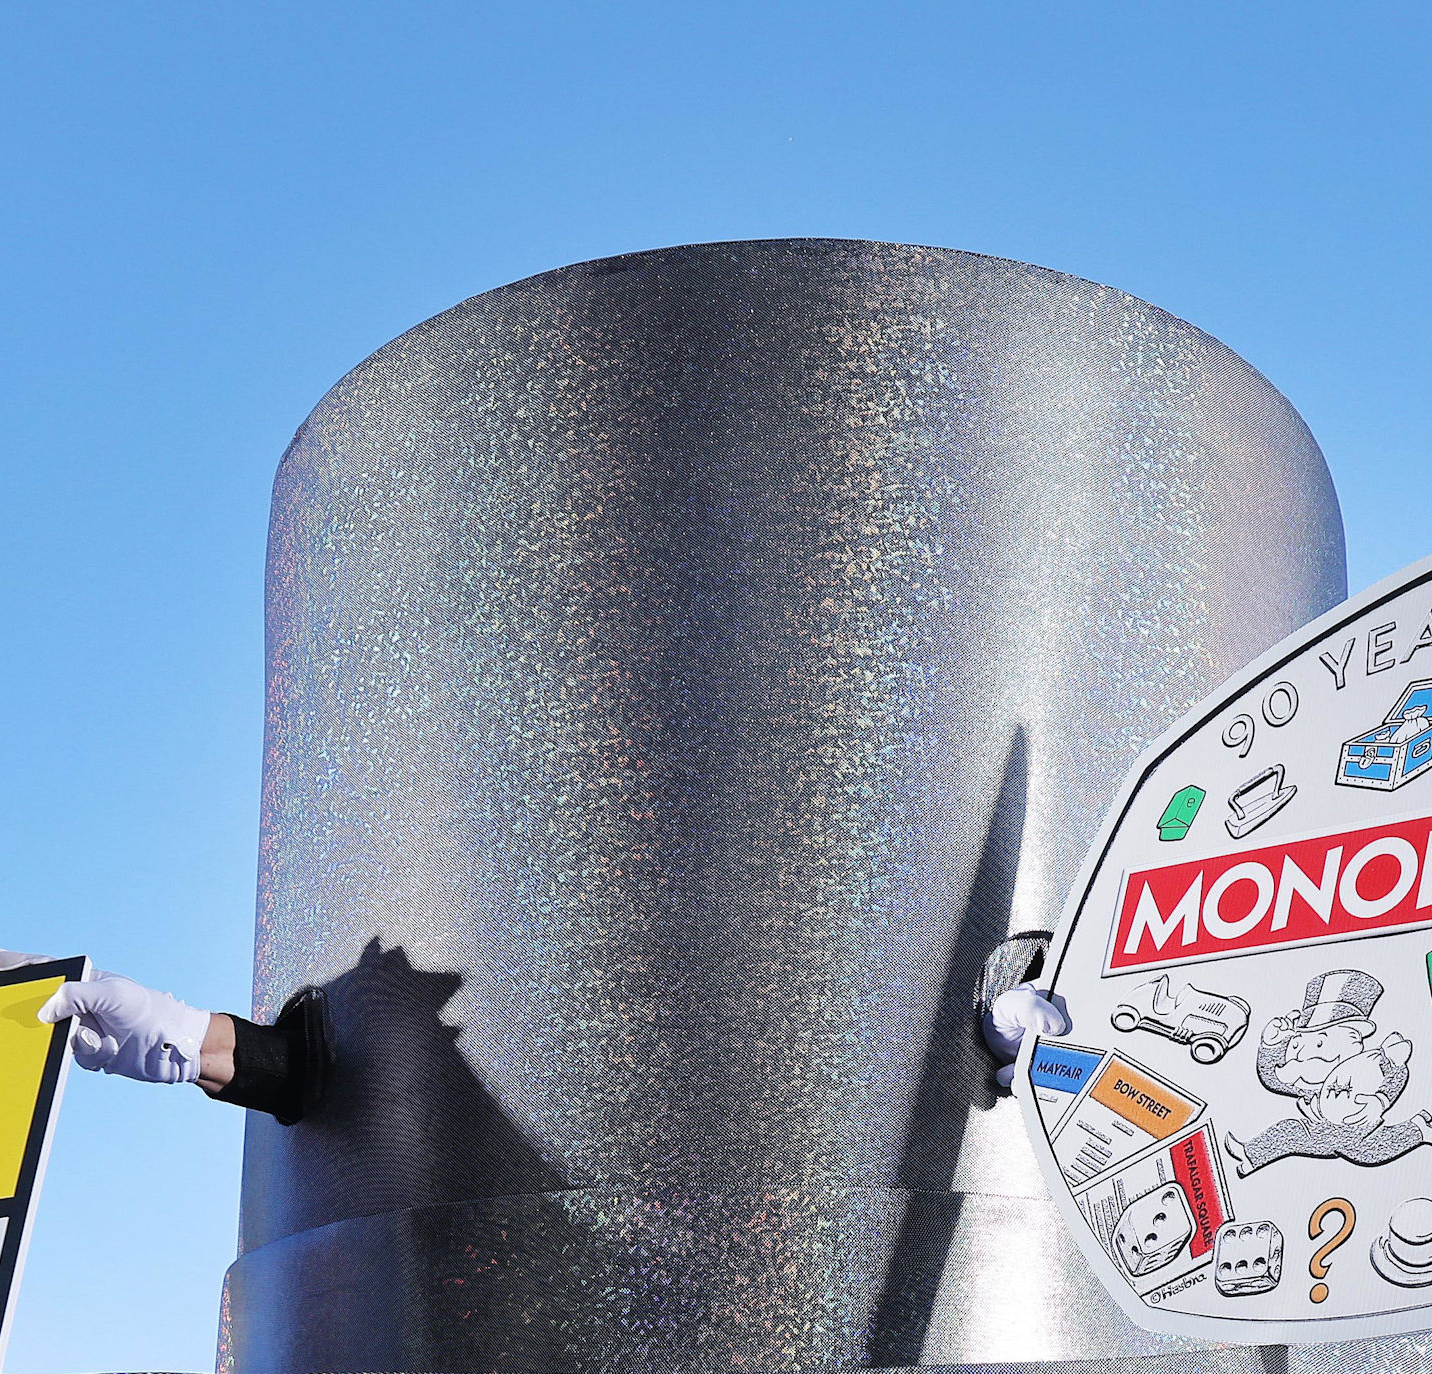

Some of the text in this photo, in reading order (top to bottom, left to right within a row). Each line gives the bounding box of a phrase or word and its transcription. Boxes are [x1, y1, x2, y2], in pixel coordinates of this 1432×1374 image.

[1221, 680, 1300, 759] 90
[1036, 1060, 1083, 1081] MAYFAIR
[1113, 1078, 1172, 1121] BOW STREET
[1182, 1139, 1215, 1248] TRAFALGAR SQUARE
